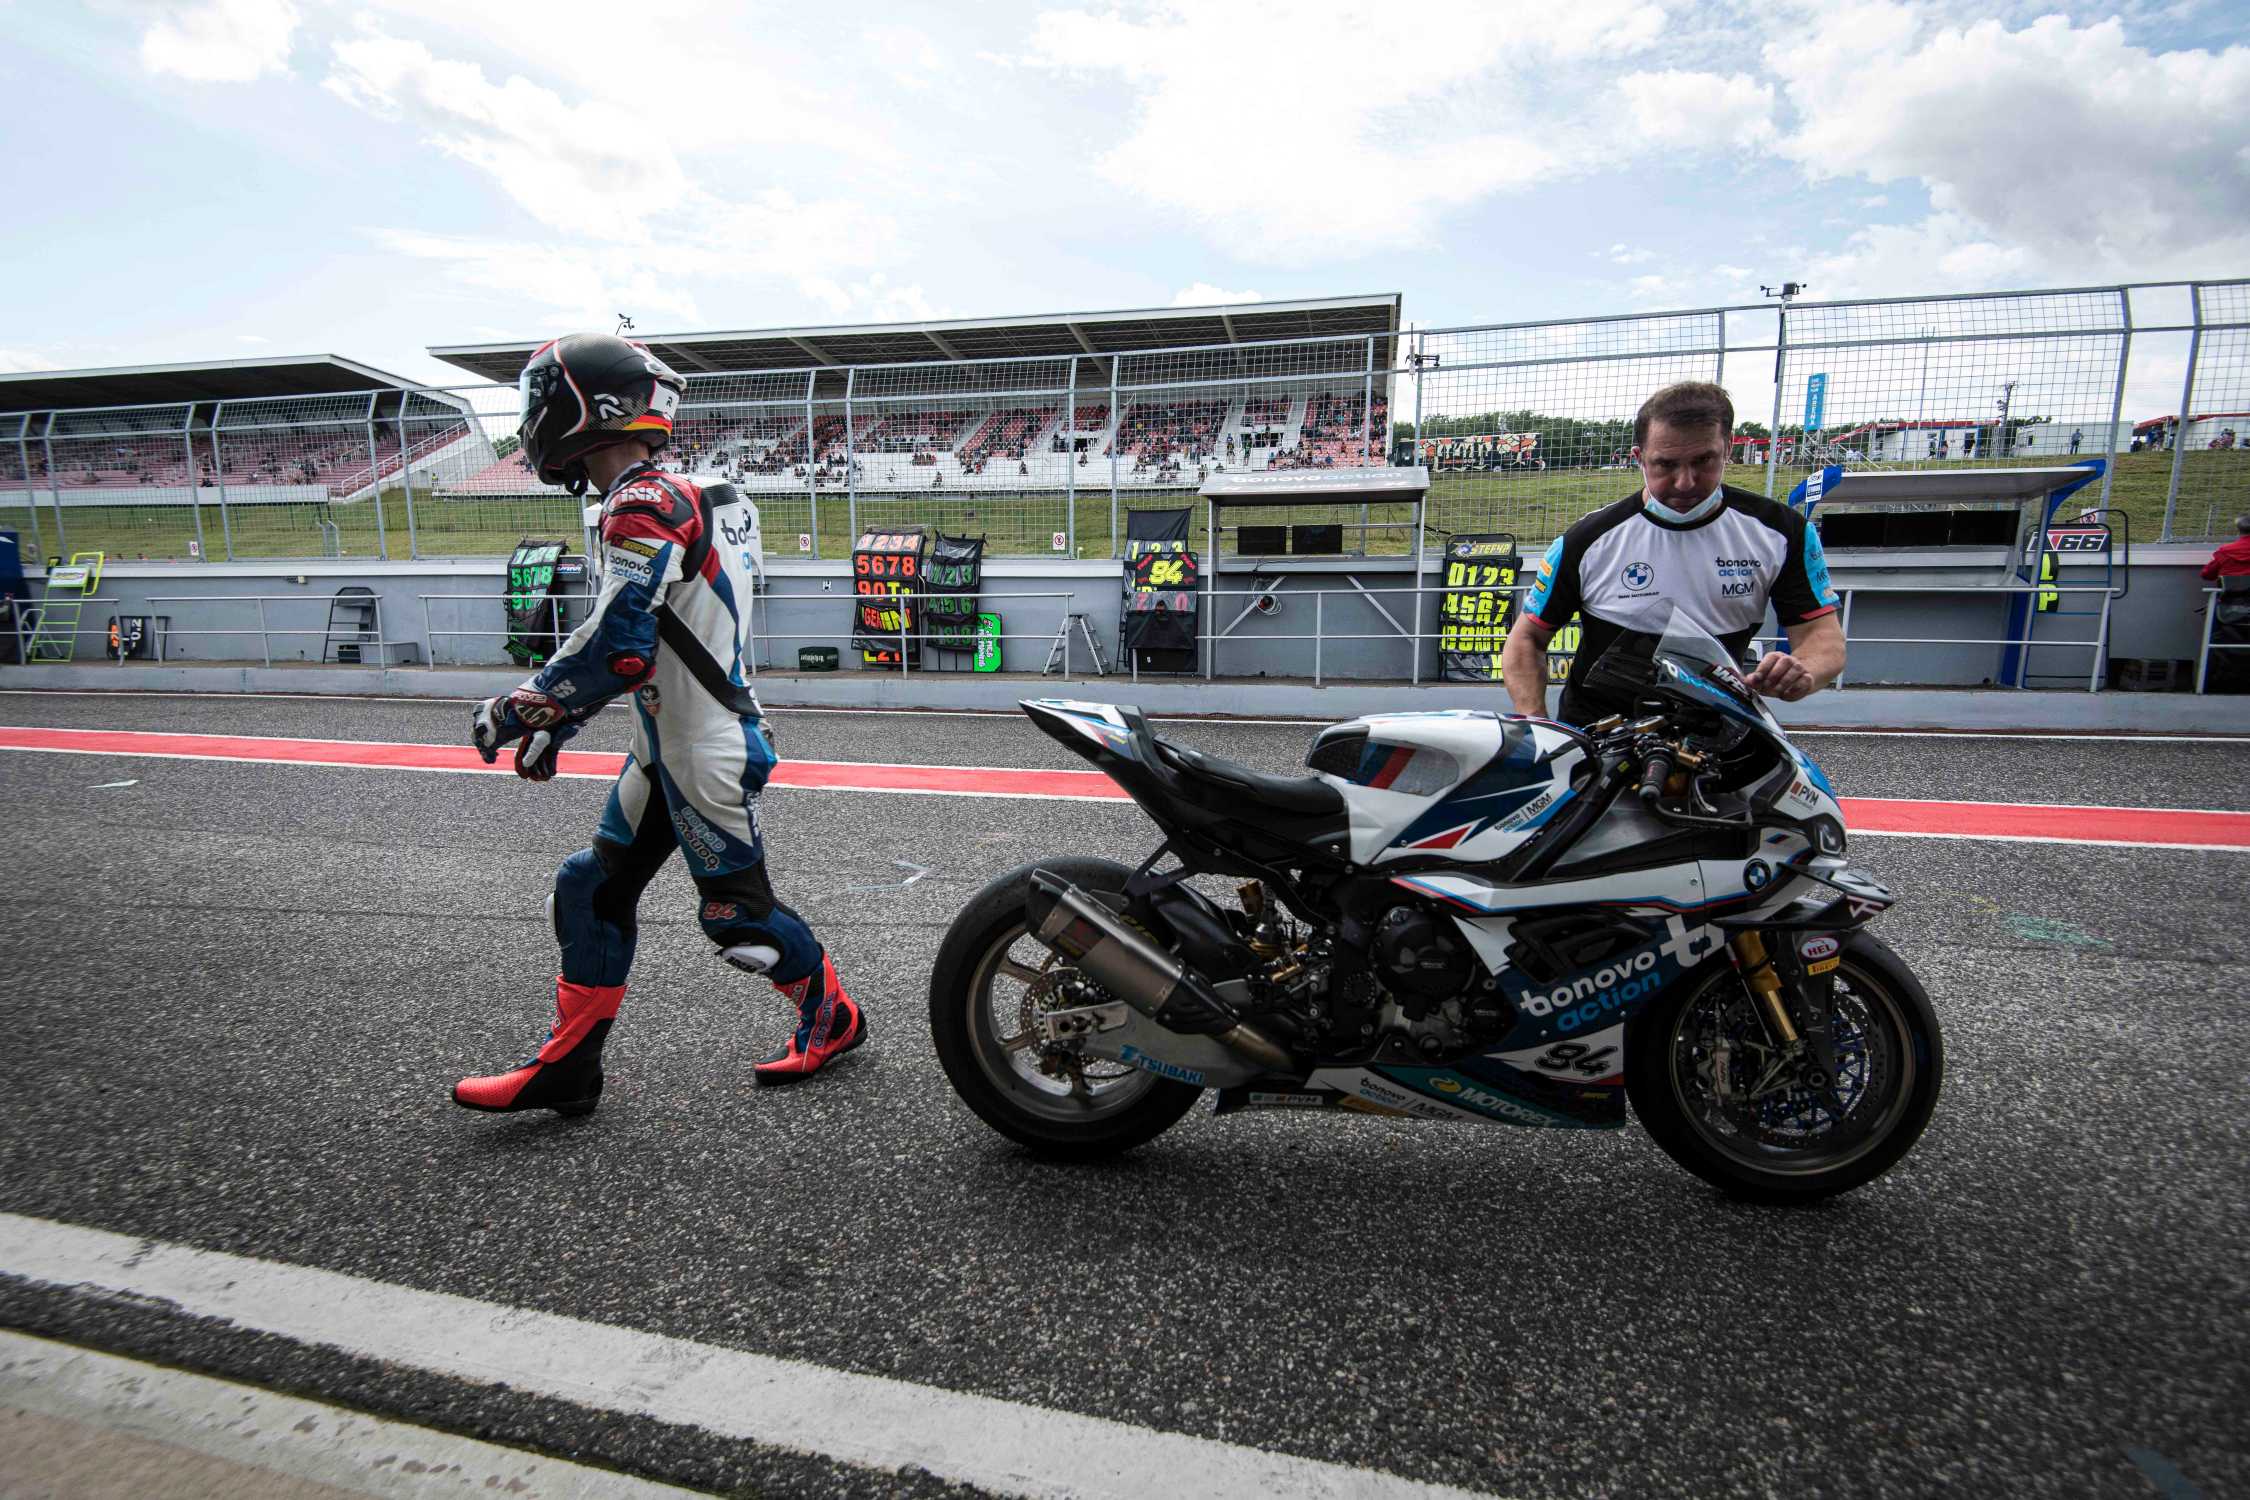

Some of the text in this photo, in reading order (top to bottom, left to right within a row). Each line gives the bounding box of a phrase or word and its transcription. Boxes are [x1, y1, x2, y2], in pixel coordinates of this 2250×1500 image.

[857, 554, 915, 576] 5678
[1722, 582, 1754, 595] MGM
[1526, 792, 1552, 814] MGM
[1799, 785, 1820, 806] PVM
[1807, 942, 1833, 956] HEL
[1519, 950, 1657, 1018] bonovo
[1556, 971, 1662, 1032] action
